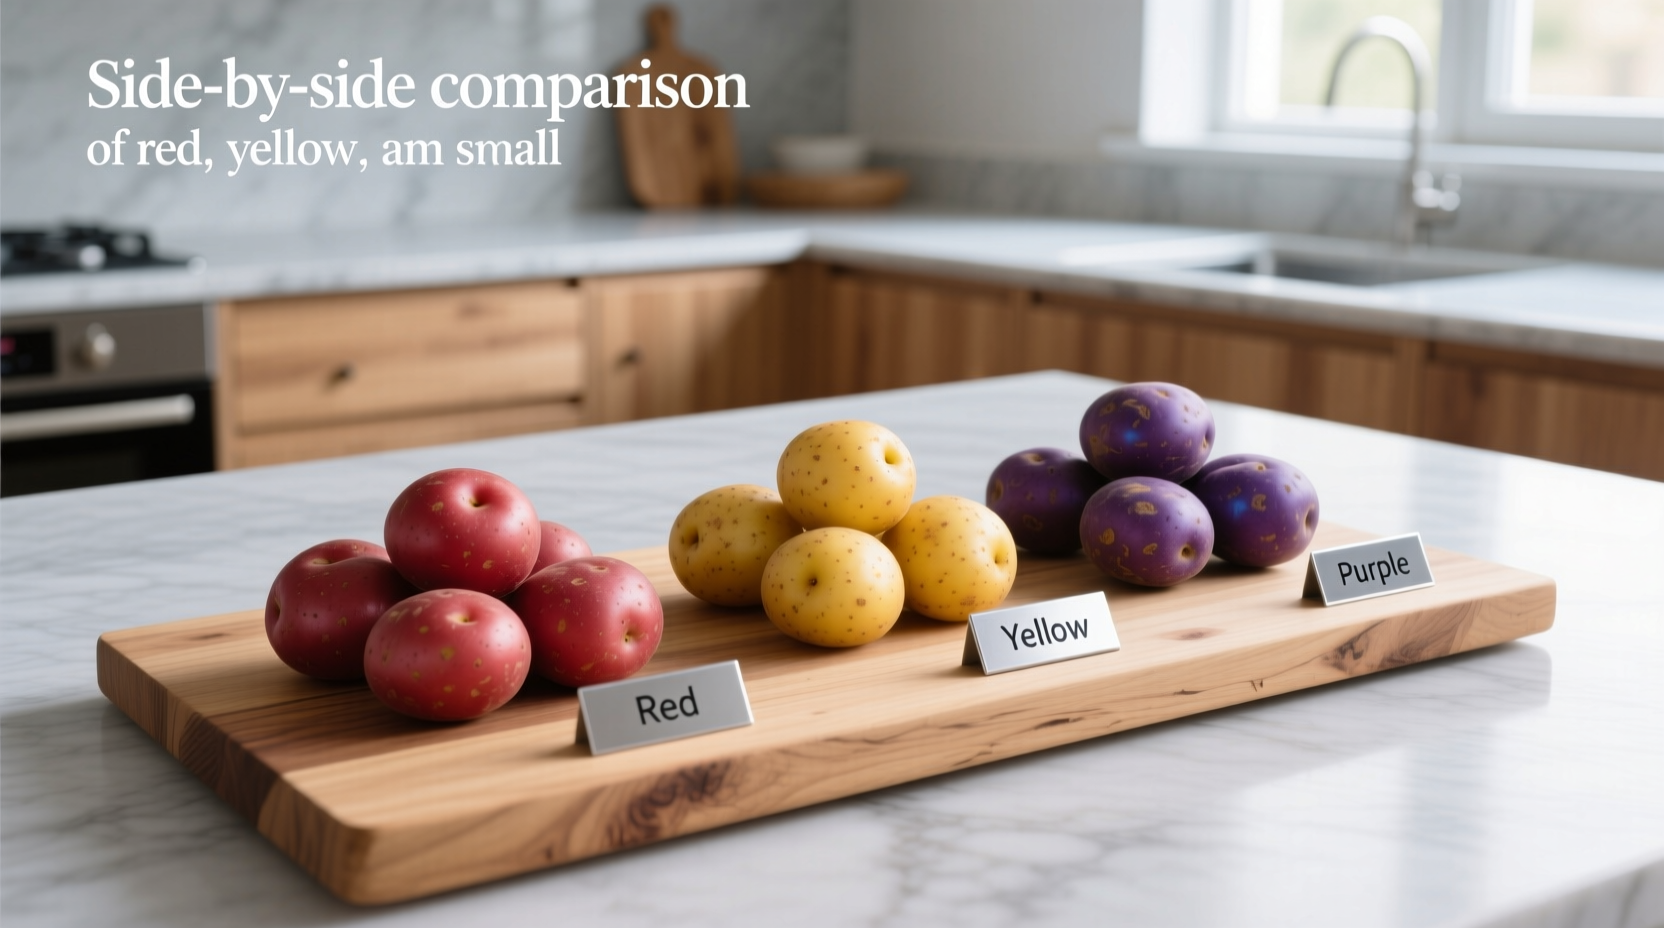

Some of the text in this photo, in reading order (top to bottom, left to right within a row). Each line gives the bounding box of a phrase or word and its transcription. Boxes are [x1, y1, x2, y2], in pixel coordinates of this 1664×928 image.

[1338, 551, 1411, 586] Purple
[1001, 616, 1089, 651] Yellow
[636, 686, 699, 725] Red
